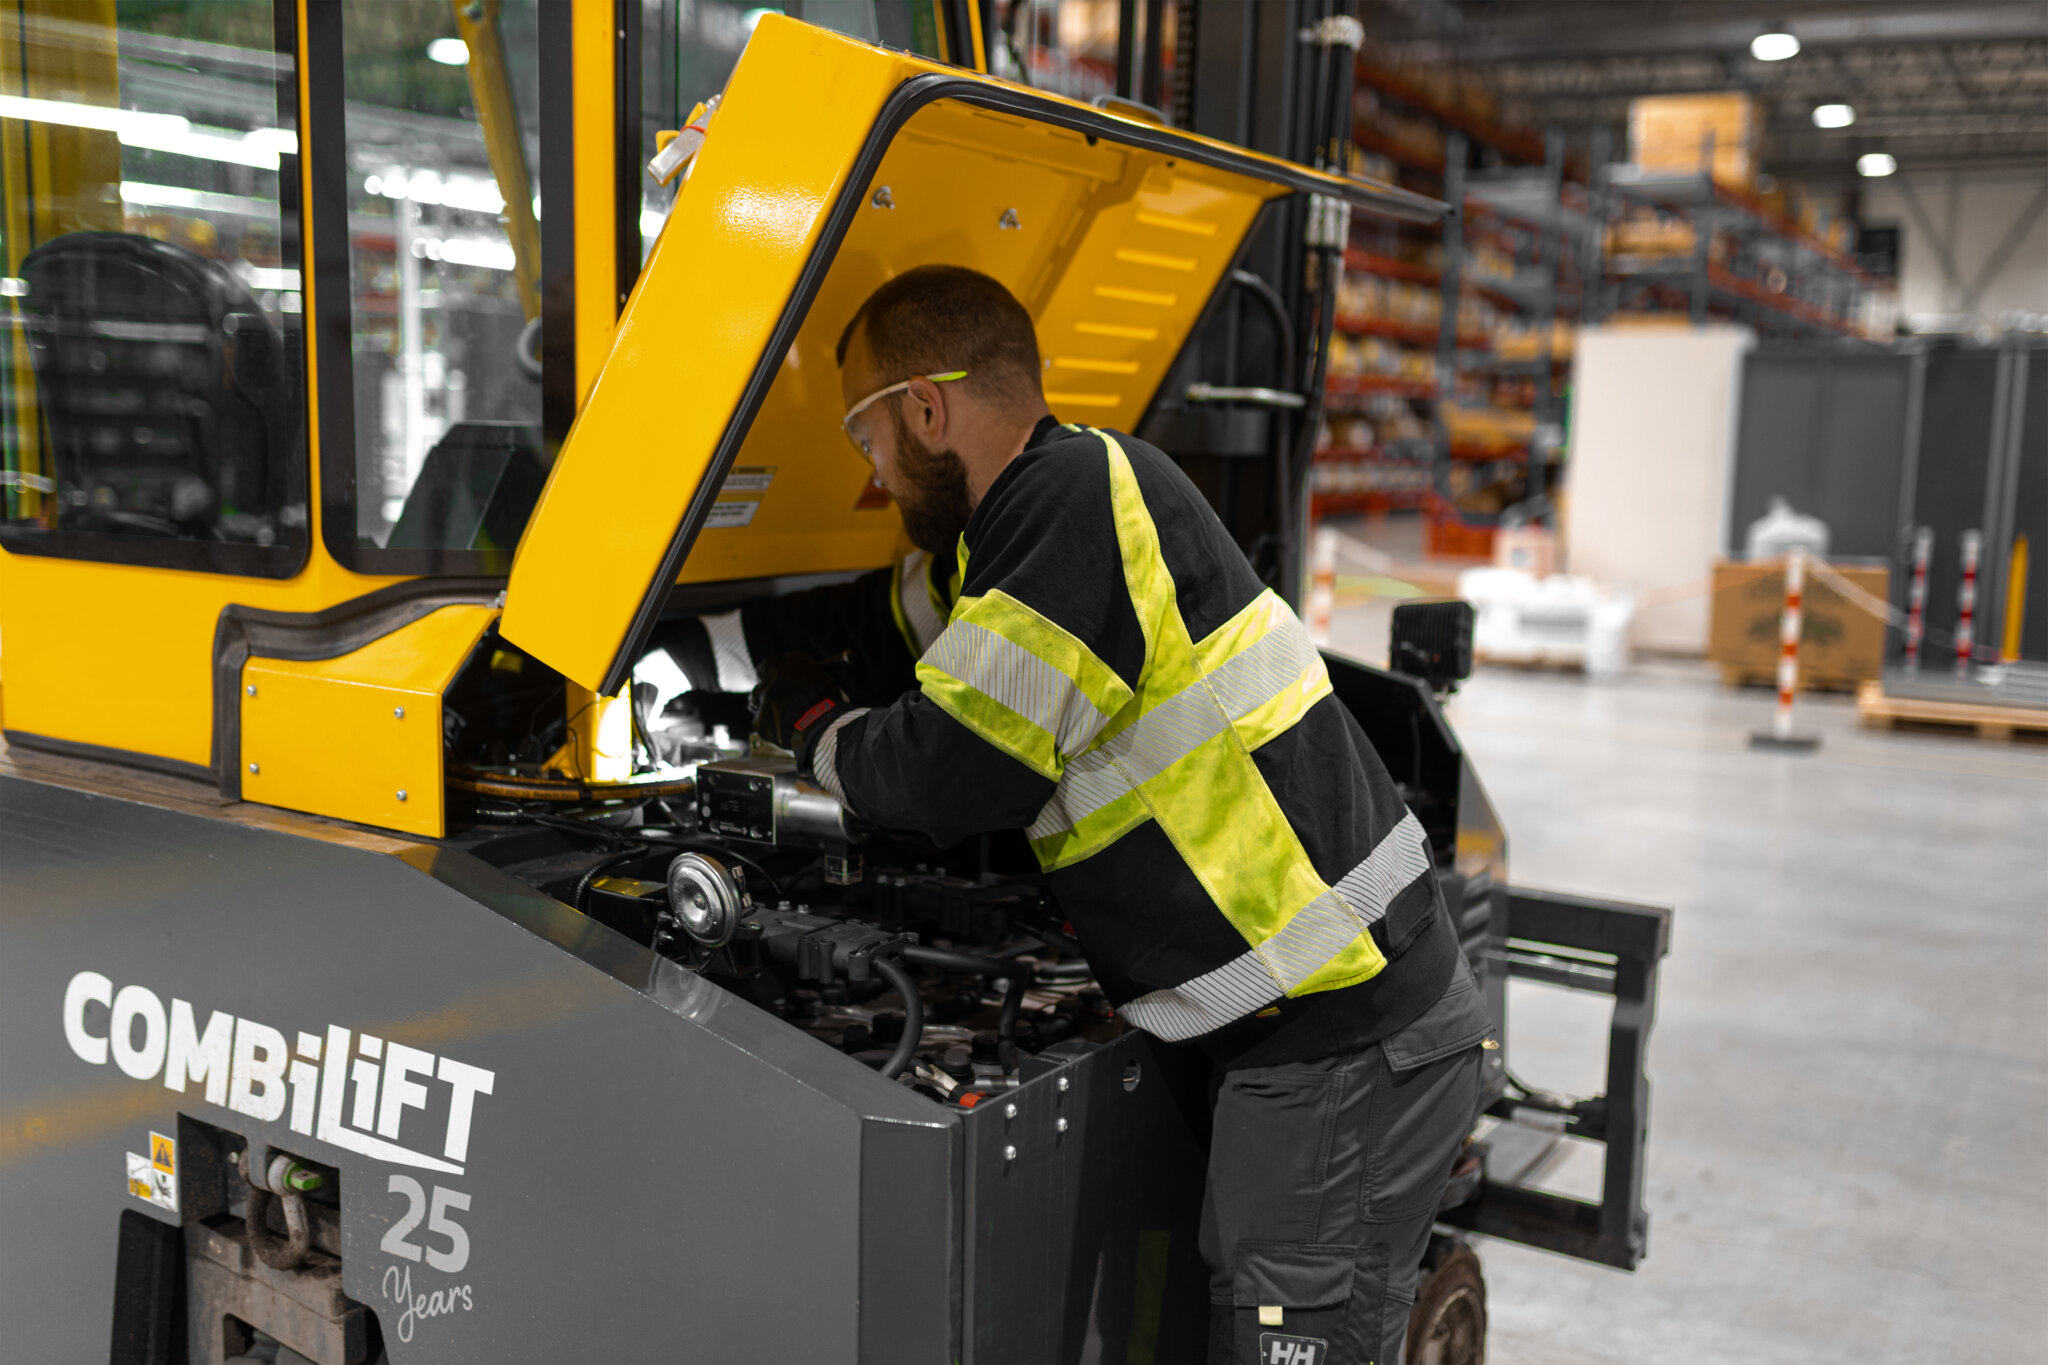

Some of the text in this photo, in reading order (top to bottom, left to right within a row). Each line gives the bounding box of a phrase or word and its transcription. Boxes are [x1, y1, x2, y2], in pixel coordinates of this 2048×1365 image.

[380, 1174, 472, 1273] 25
[382, 1265, 473, 1343] Years
[1270, 1340, 1316, 1365] HH
